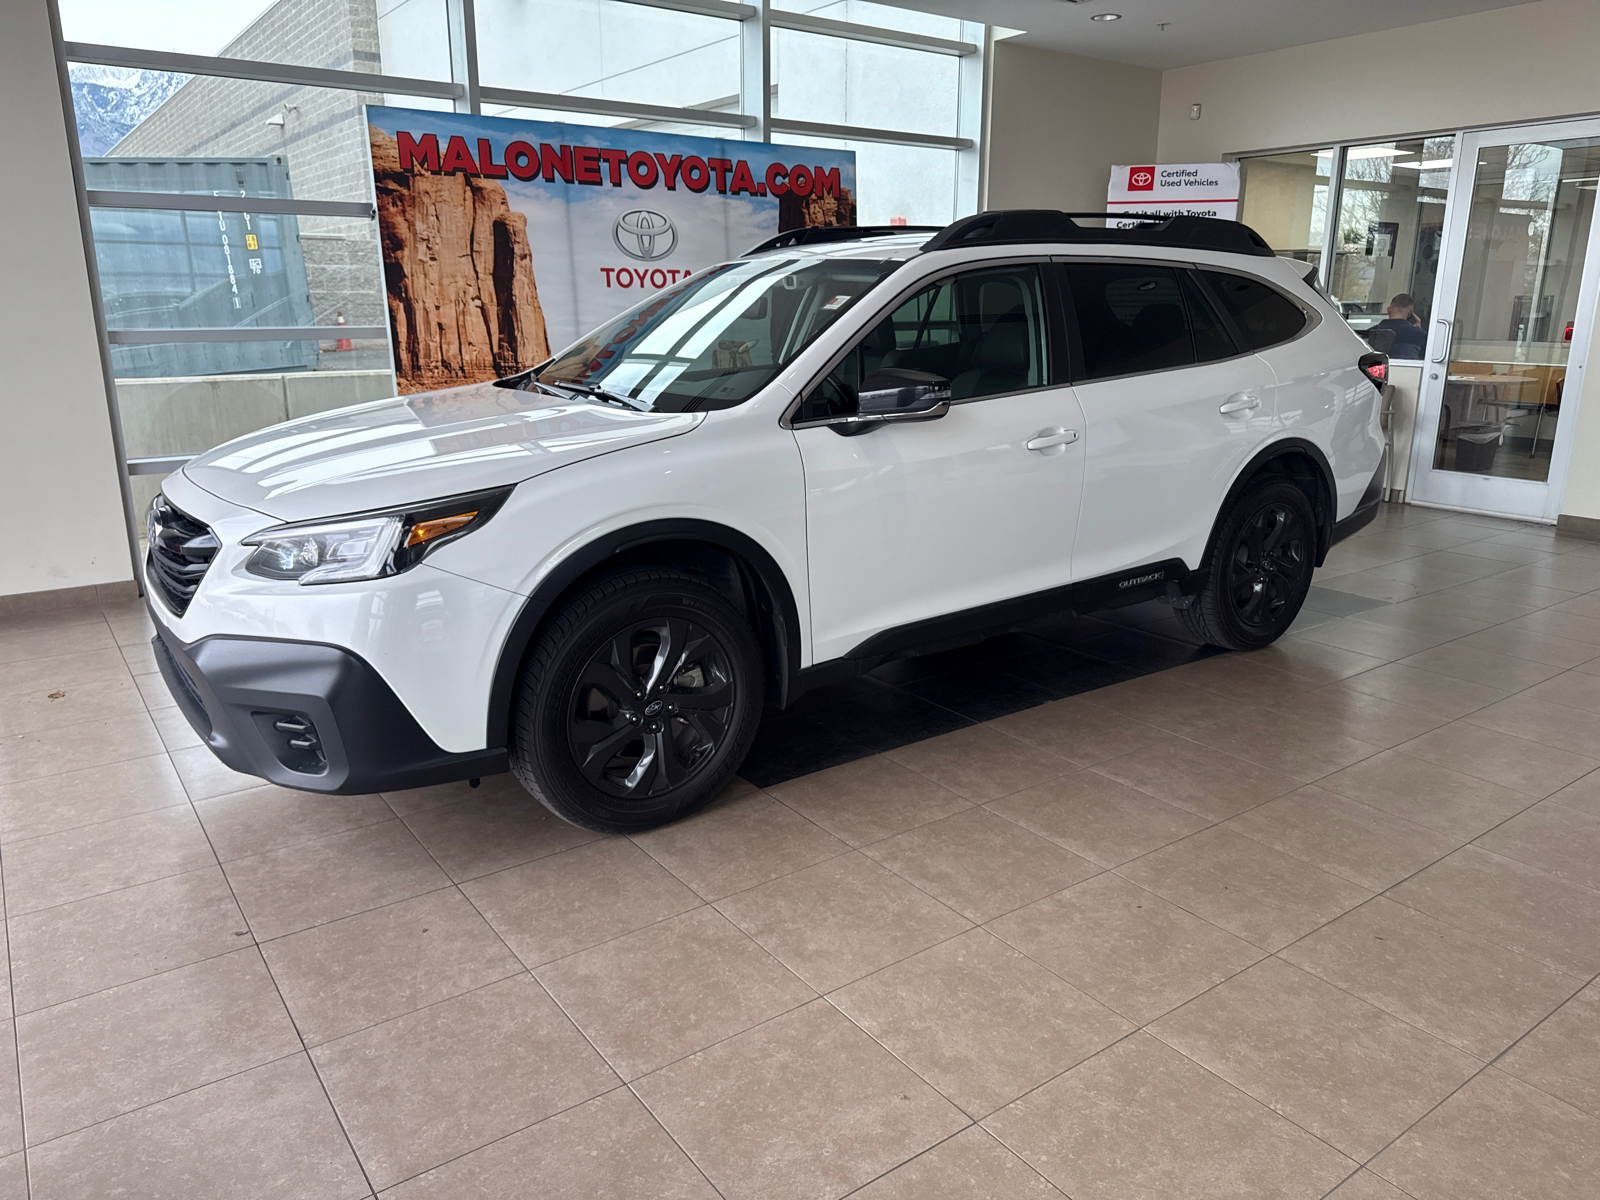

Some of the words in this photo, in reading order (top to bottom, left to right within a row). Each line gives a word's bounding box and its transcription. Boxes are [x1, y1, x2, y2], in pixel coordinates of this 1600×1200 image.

[396, 130, 842, 199] MALONETOYOTA.COM
[1160, 169, 1198, 178] Certified
[1160, 179, 1182, 187] Used
[1184, 178, 1219, 187] Vehicles
[1163, 209, 1184, 217] with
[1186, 209, 1217, 217] Toyota
[1118, 571, 1165, 588] OUTBACK
